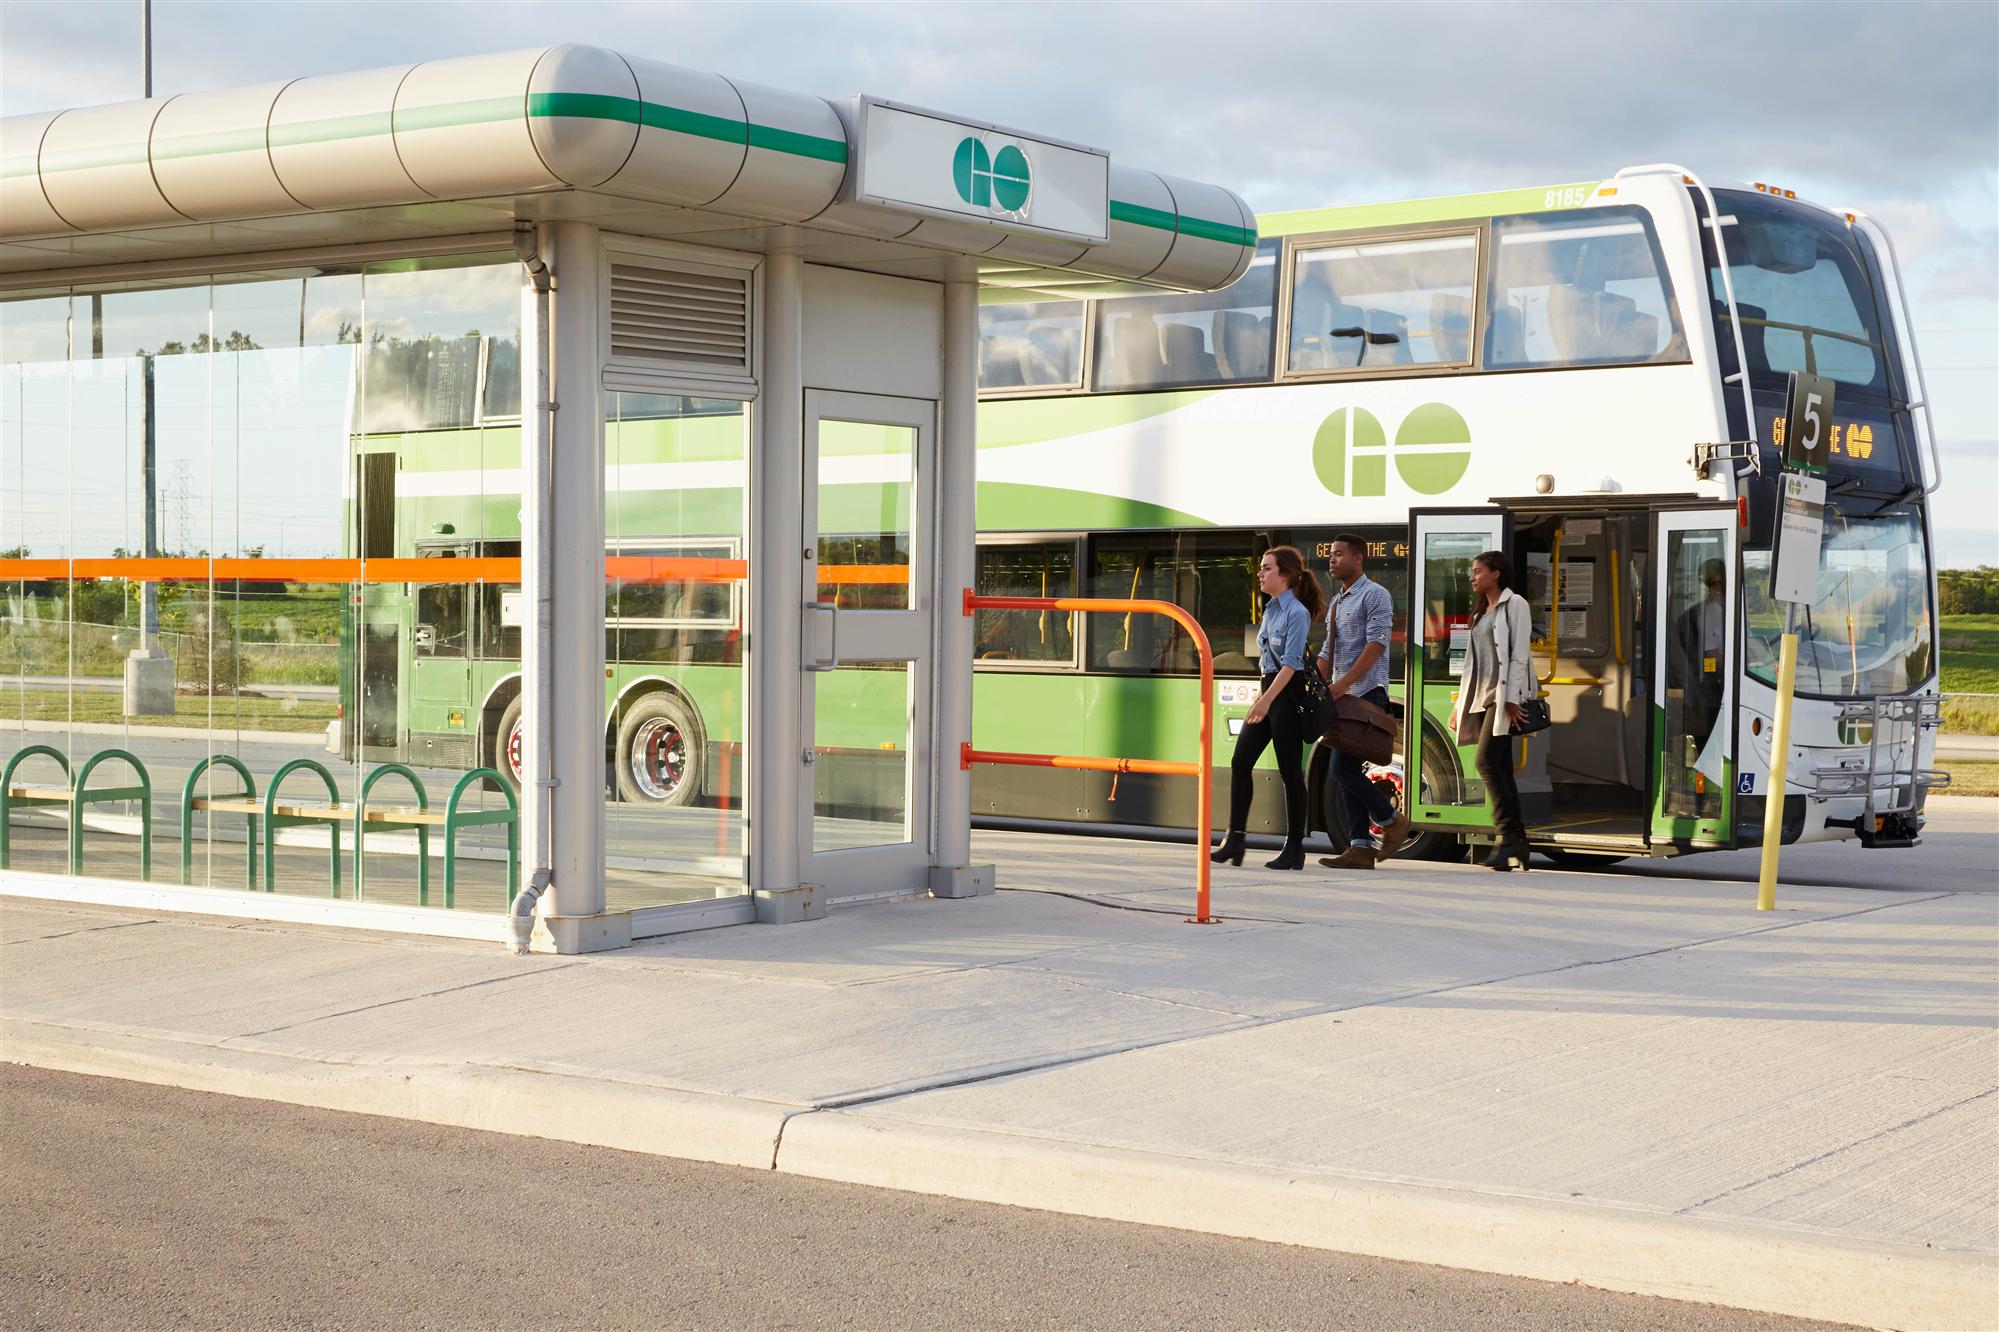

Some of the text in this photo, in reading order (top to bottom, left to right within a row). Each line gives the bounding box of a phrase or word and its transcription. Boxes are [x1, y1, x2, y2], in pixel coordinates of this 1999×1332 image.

[953, 137, 1030, 212] GO
[1544, 187, 1585, 209] 8185
[1801, 392, 1822, 450] 5
[1312, 402, 1472, 497] GO
[1846, 423, 1873, 459] GO
[1788, 478, 1802, 495] GO
[1366, 542, 1387, 557] THE
